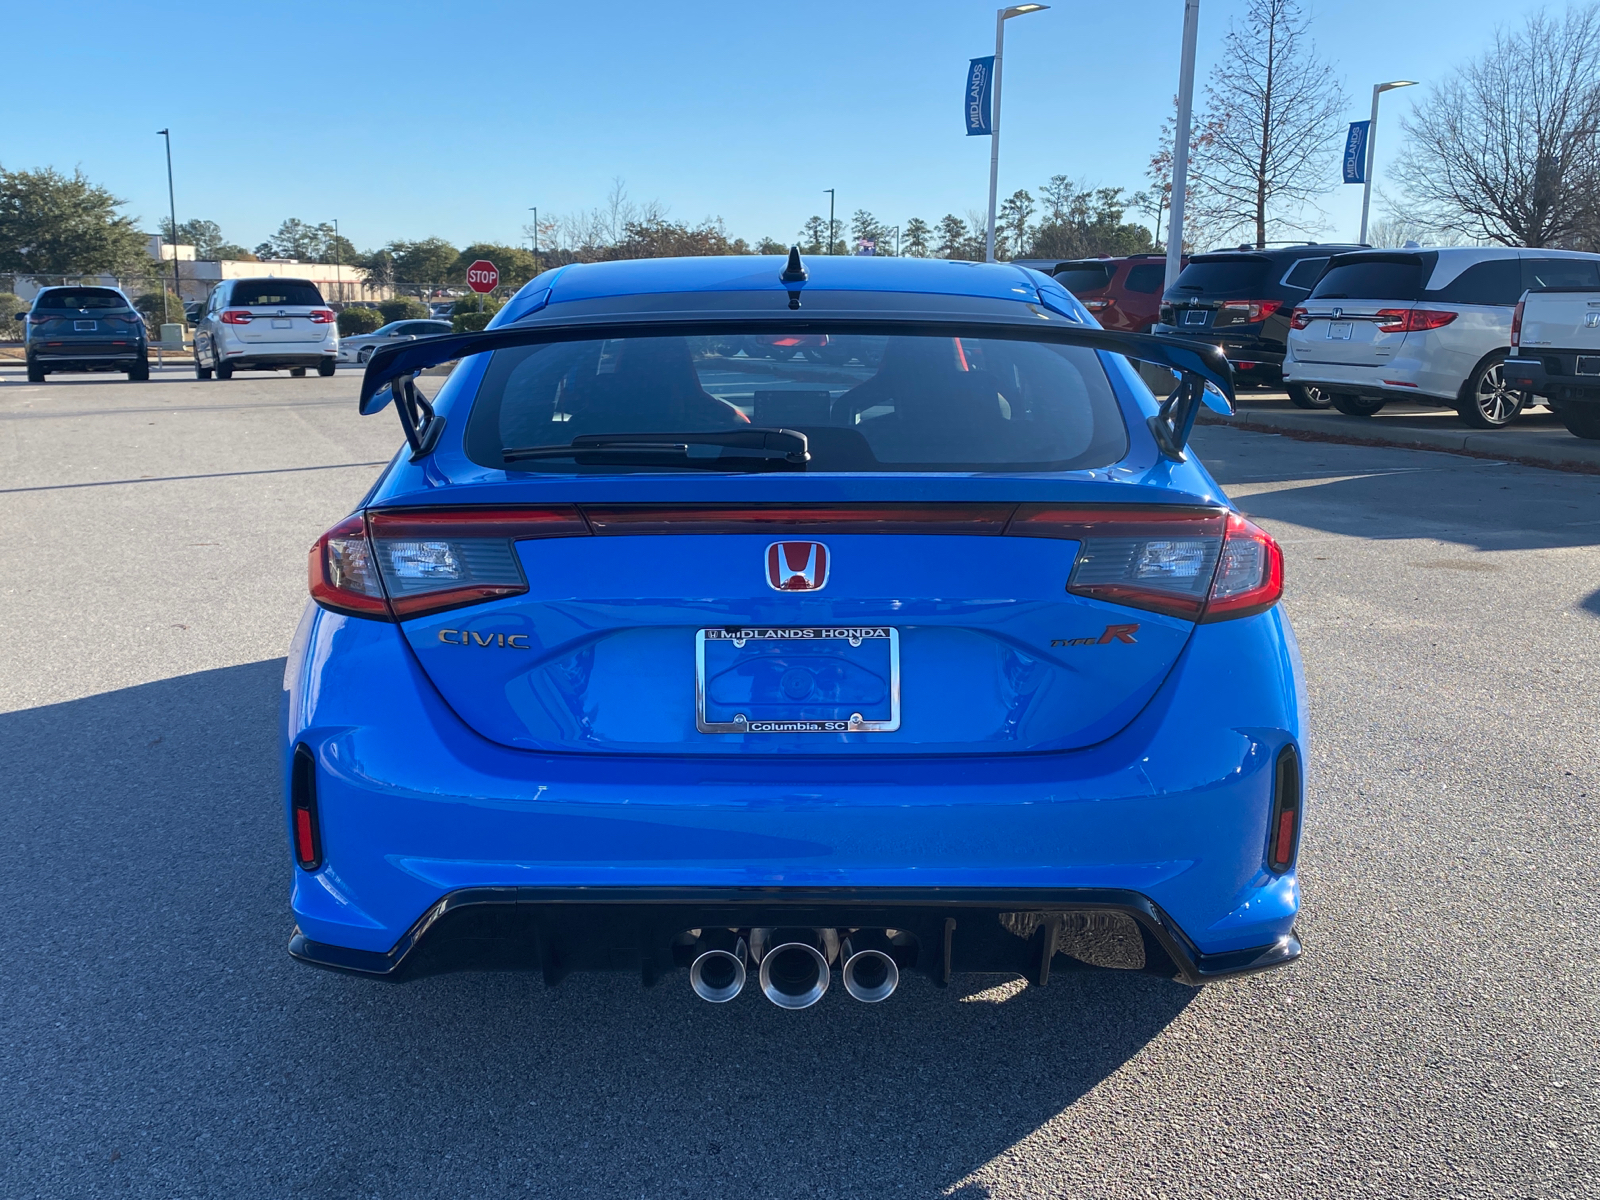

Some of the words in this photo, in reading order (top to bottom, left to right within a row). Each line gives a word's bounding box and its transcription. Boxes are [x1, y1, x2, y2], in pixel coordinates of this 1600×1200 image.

[970, 63, 982, 128] MIDLANDS
[1346, 126, 1360, 178] MIDLANDS
[469, 270, 497, 284] STOP
[438, 629, 530, 650] CIVIC
[821, 628, 887, 638] HONDA
[1096, 623, 1141, 645] R
[824, 722, 846, 730] SC
